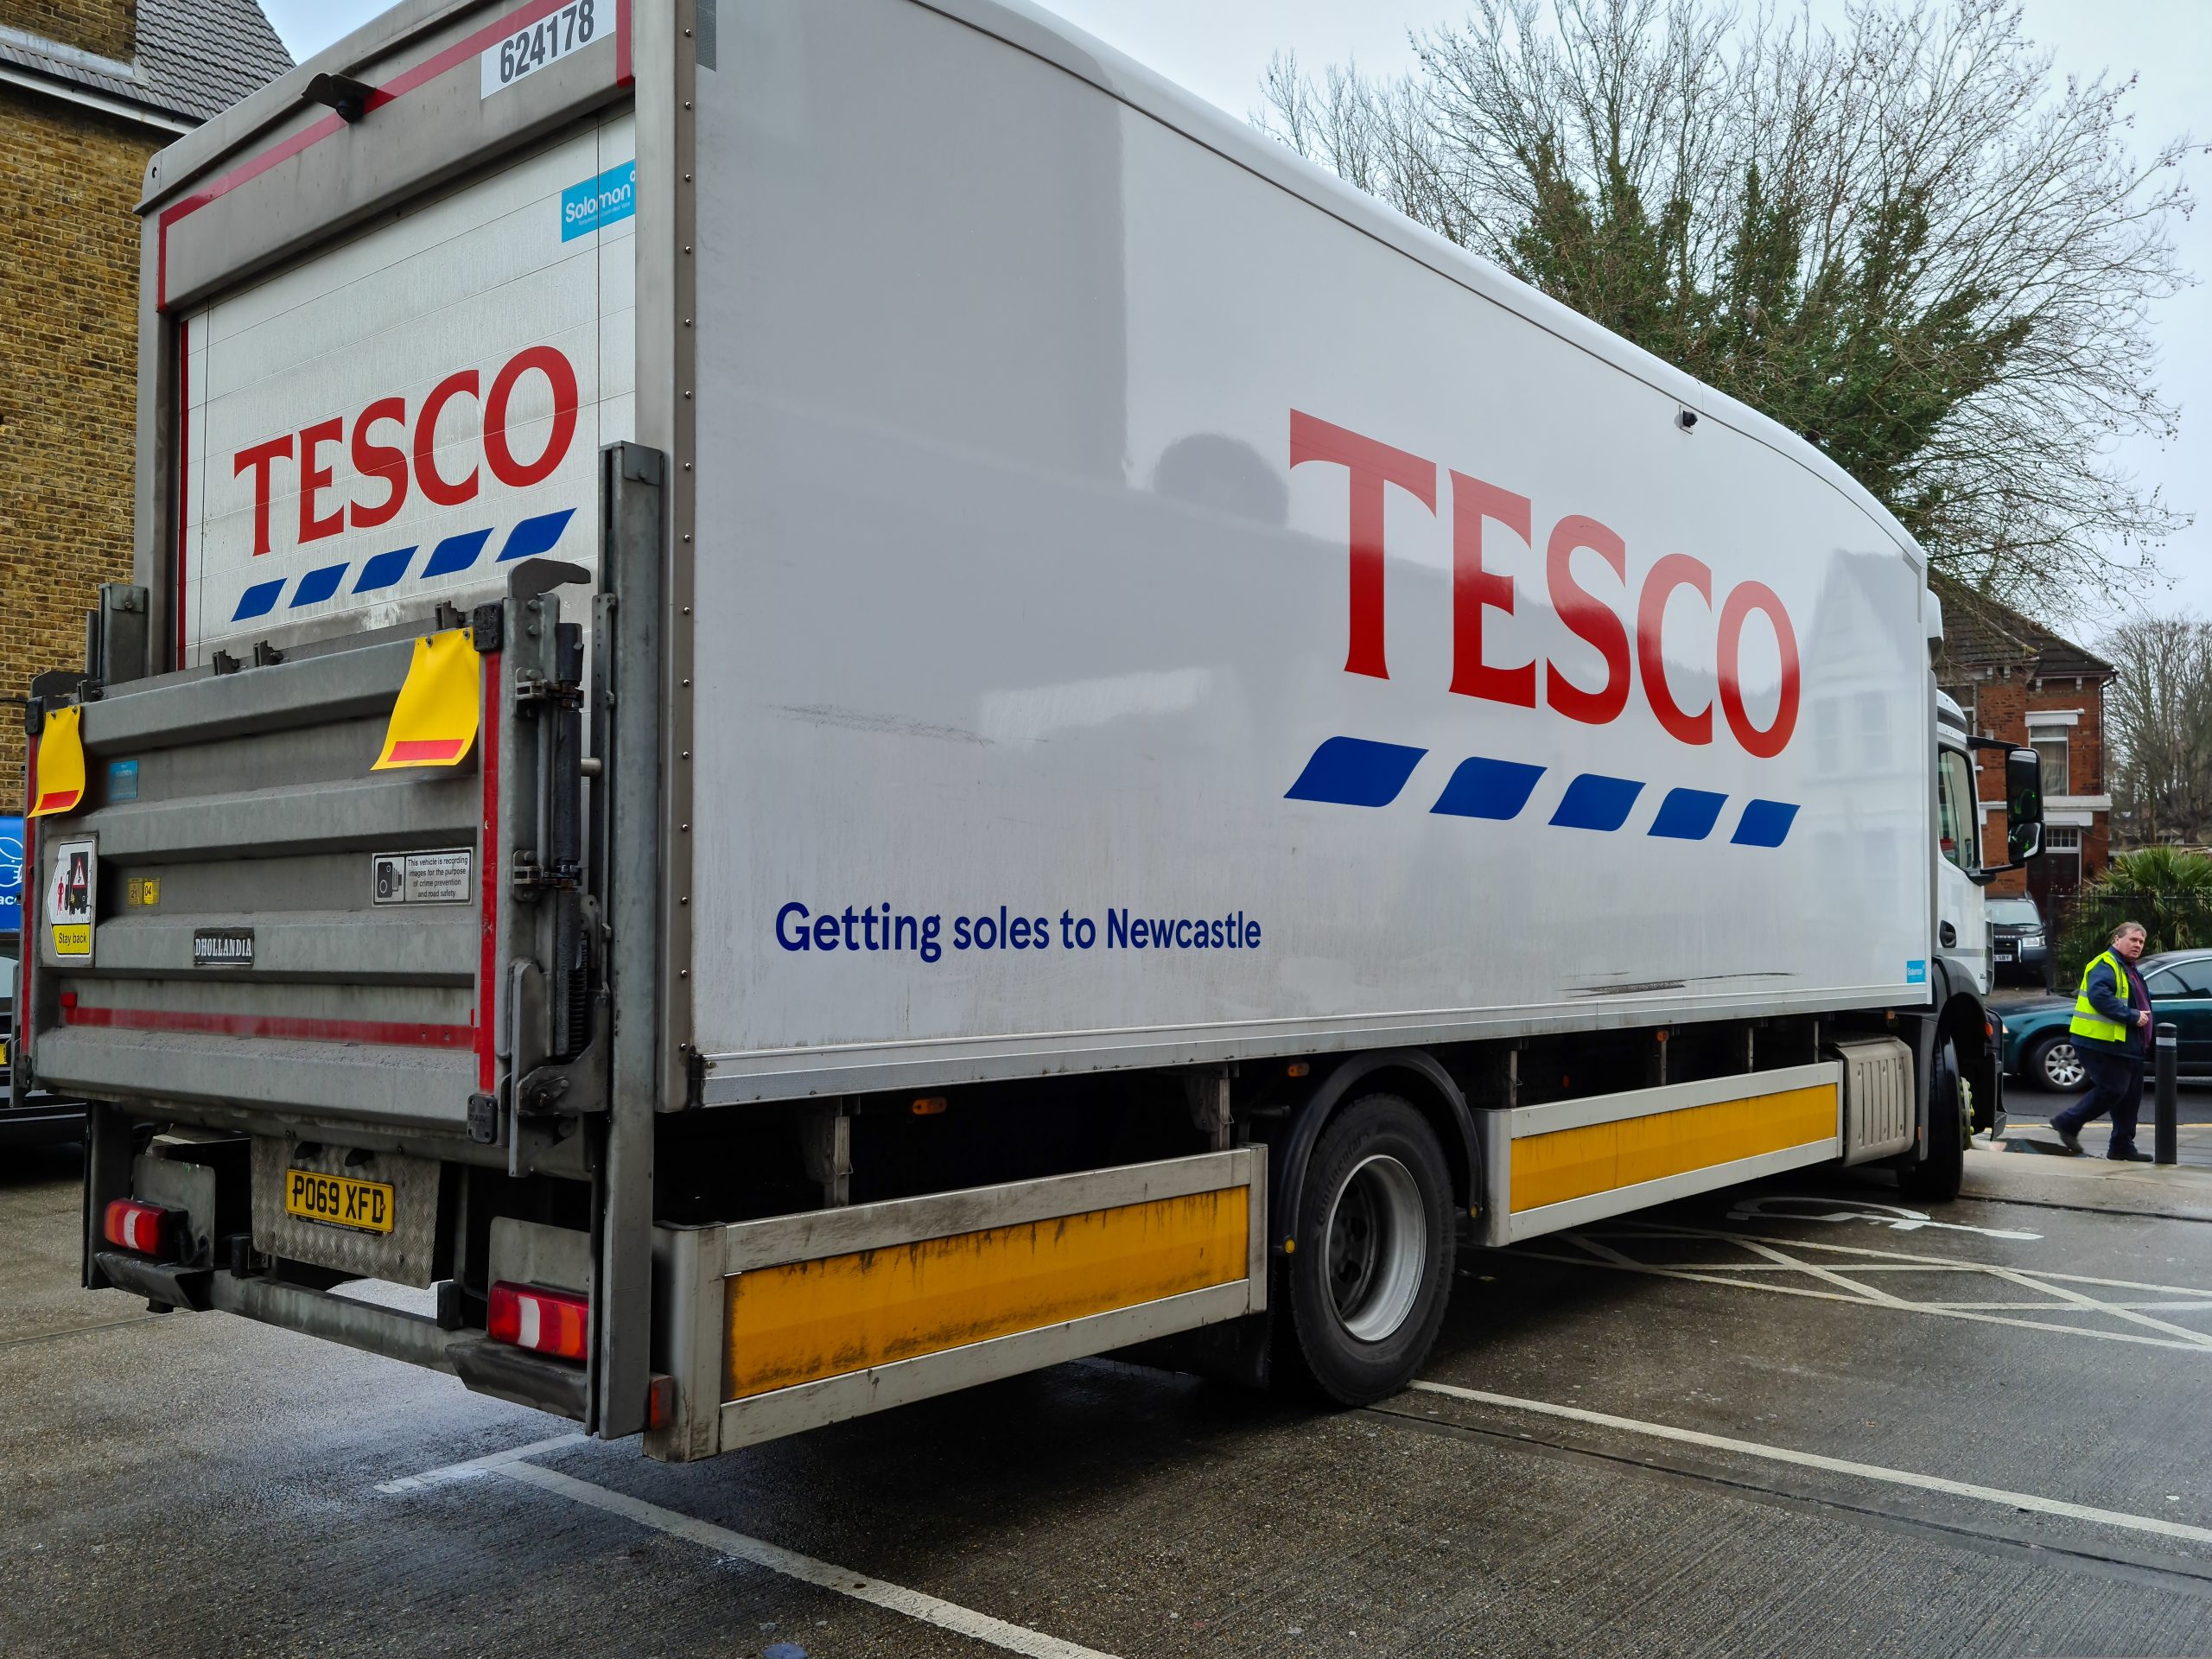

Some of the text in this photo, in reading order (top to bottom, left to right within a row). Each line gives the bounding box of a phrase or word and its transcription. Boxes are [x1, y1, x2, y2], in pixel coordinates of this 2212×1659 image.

[500, 0, 594, 84] 624178
[565, 183, 631, 223] Solomon
[234, 346, 578, 557] TESCO
[1290, 408, 1801, 759] TESCO
[443, 856, 468, 866] recording
[445, 868, 466, 877] purpose
[434, 878, 461, 887] prevention
[440, 889, 456, 899] safety
[58, 931, 87, 947] Stay back
[775, 900, 1262, 963] Getting soles to Newcastle
[194, 938, 252, 957] DHOLLANDIA
[345, 1184, 386, 1224] XFD
